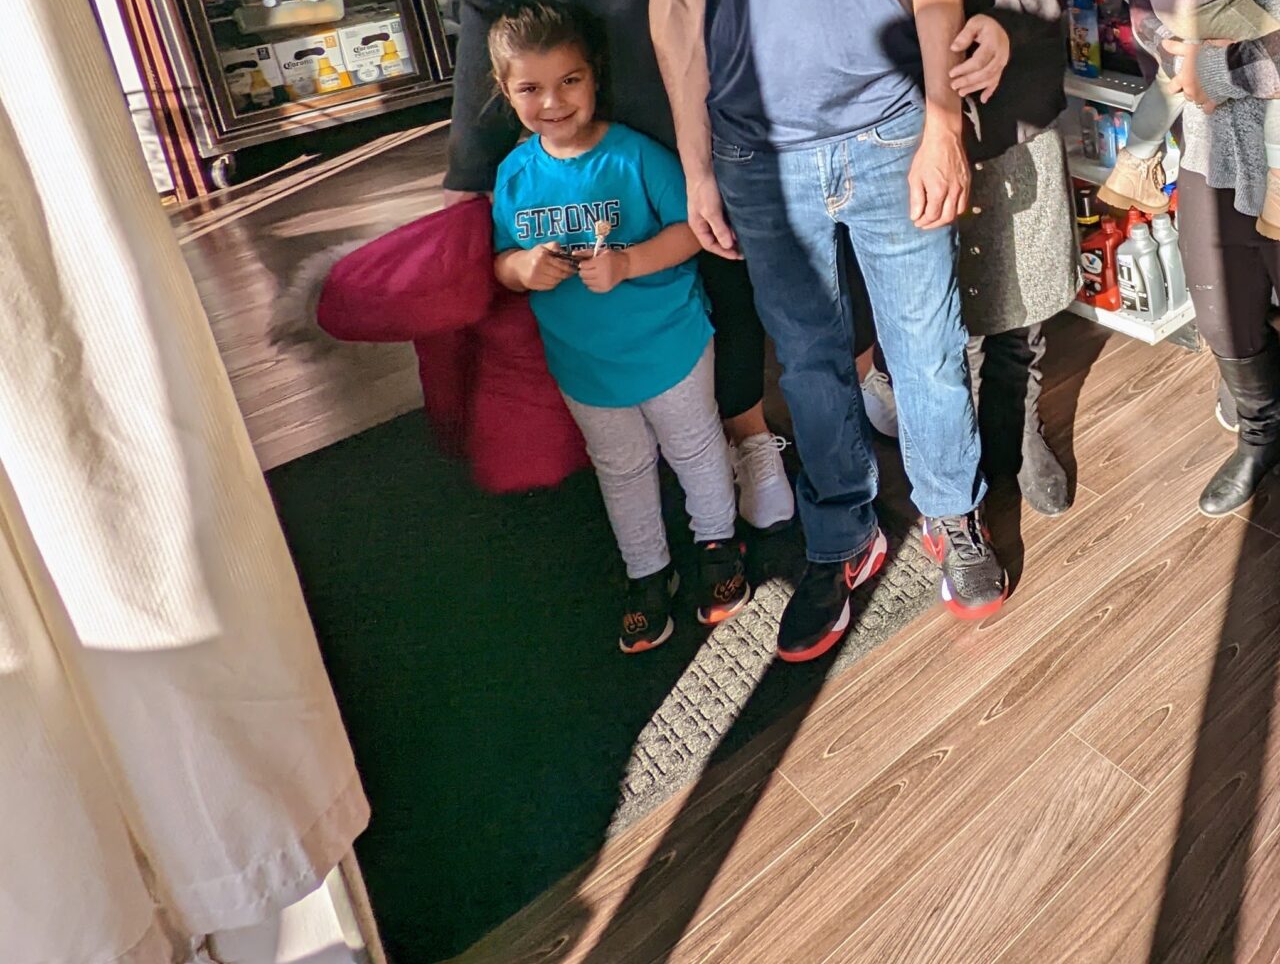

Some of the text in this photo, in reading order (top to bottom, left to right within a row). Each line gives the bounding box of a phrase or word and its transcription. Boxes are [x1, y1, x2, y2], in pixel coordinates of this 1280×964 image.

[354, 43, 379, 54] Corona
[283, 58, 314, 70] Corona
[515, 200, 620, 240] STRONG
